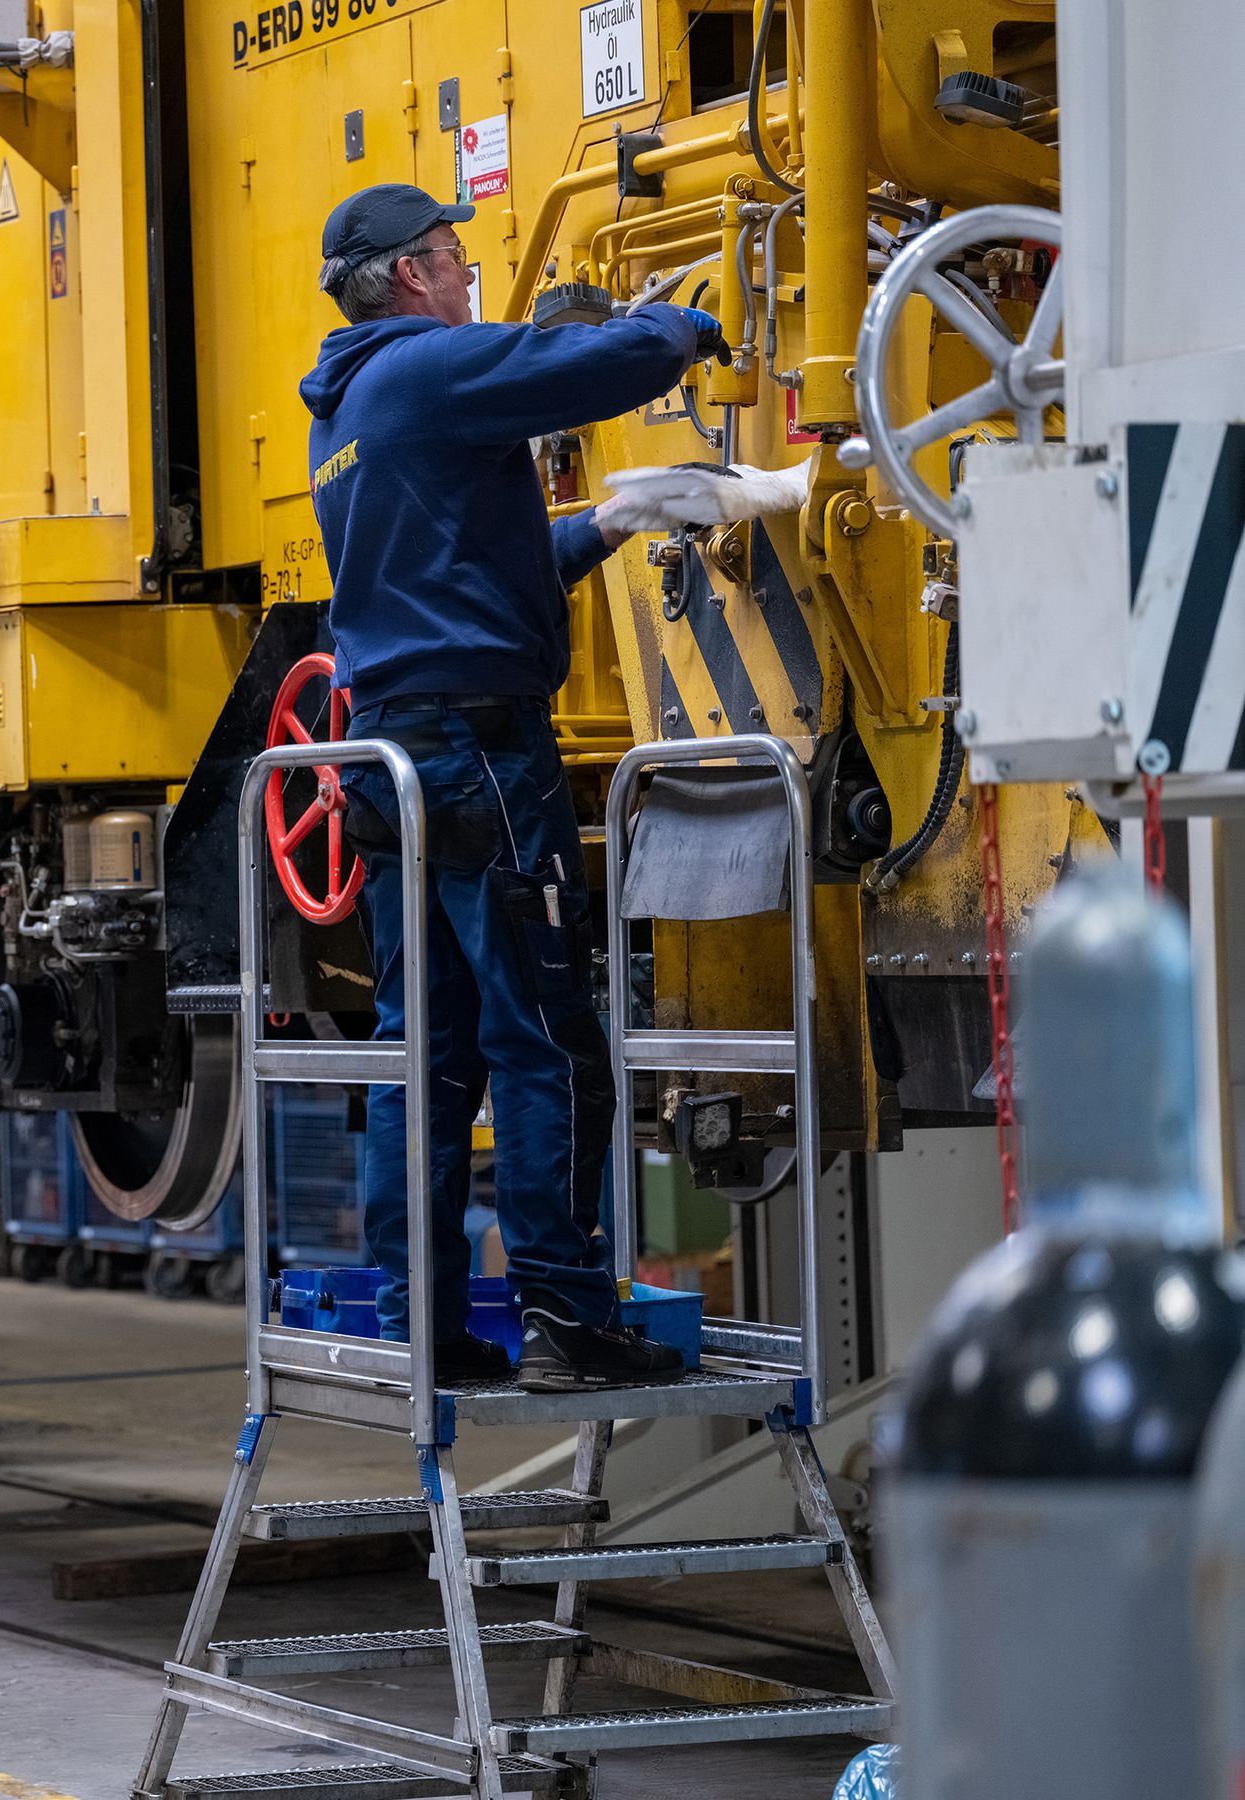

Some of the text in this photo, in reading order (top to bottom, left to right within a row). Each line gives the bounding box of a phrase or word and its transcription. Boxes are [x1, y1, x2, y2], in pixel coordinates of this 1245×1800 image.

[232, 0, 303, 63] D-ERD
[588, 0, 636, 37] Hydraulik
[607, 32, 618, 60] Öl
[595, 62, 638, 105] 650 L
[473, 177, 501, 195] PANOLIN
[314, 439, 359, 494] PIRTEK
[283, 538, 315, 564] KE-GP
